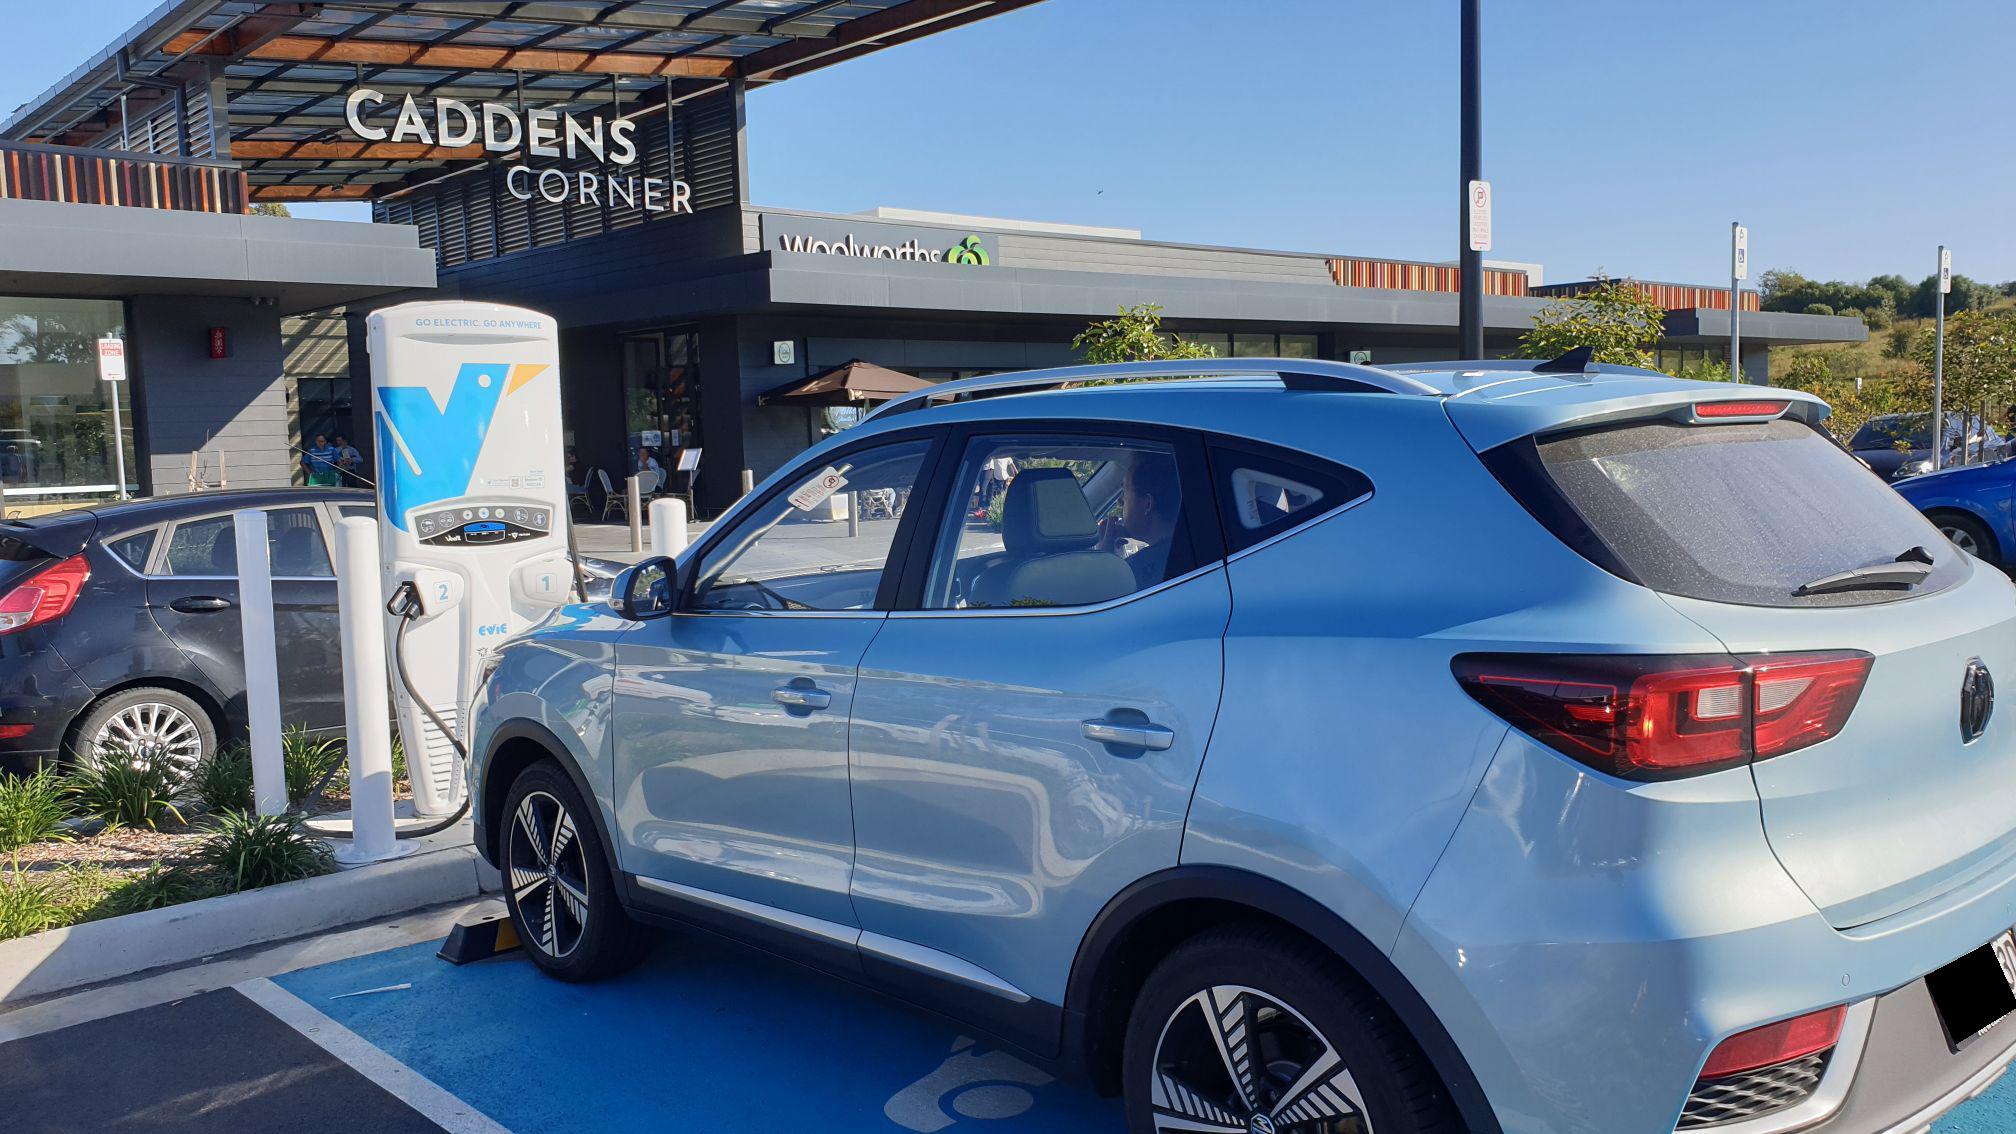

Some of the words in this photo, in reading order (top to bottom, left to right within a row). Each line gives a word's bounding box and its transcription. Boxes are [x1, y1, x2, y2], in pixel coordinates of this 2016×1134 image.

[345, 89, 637, 165] CADDENS
[506, 165, 694, 214] CORNER
[415, 318, 431, 327] GO
[483, 319, 497, 328] GO
[499, 320, 542, 329] ANYWHERE
[542, 575, 550, 591] 1
[438, 584, 449, 600] 2
